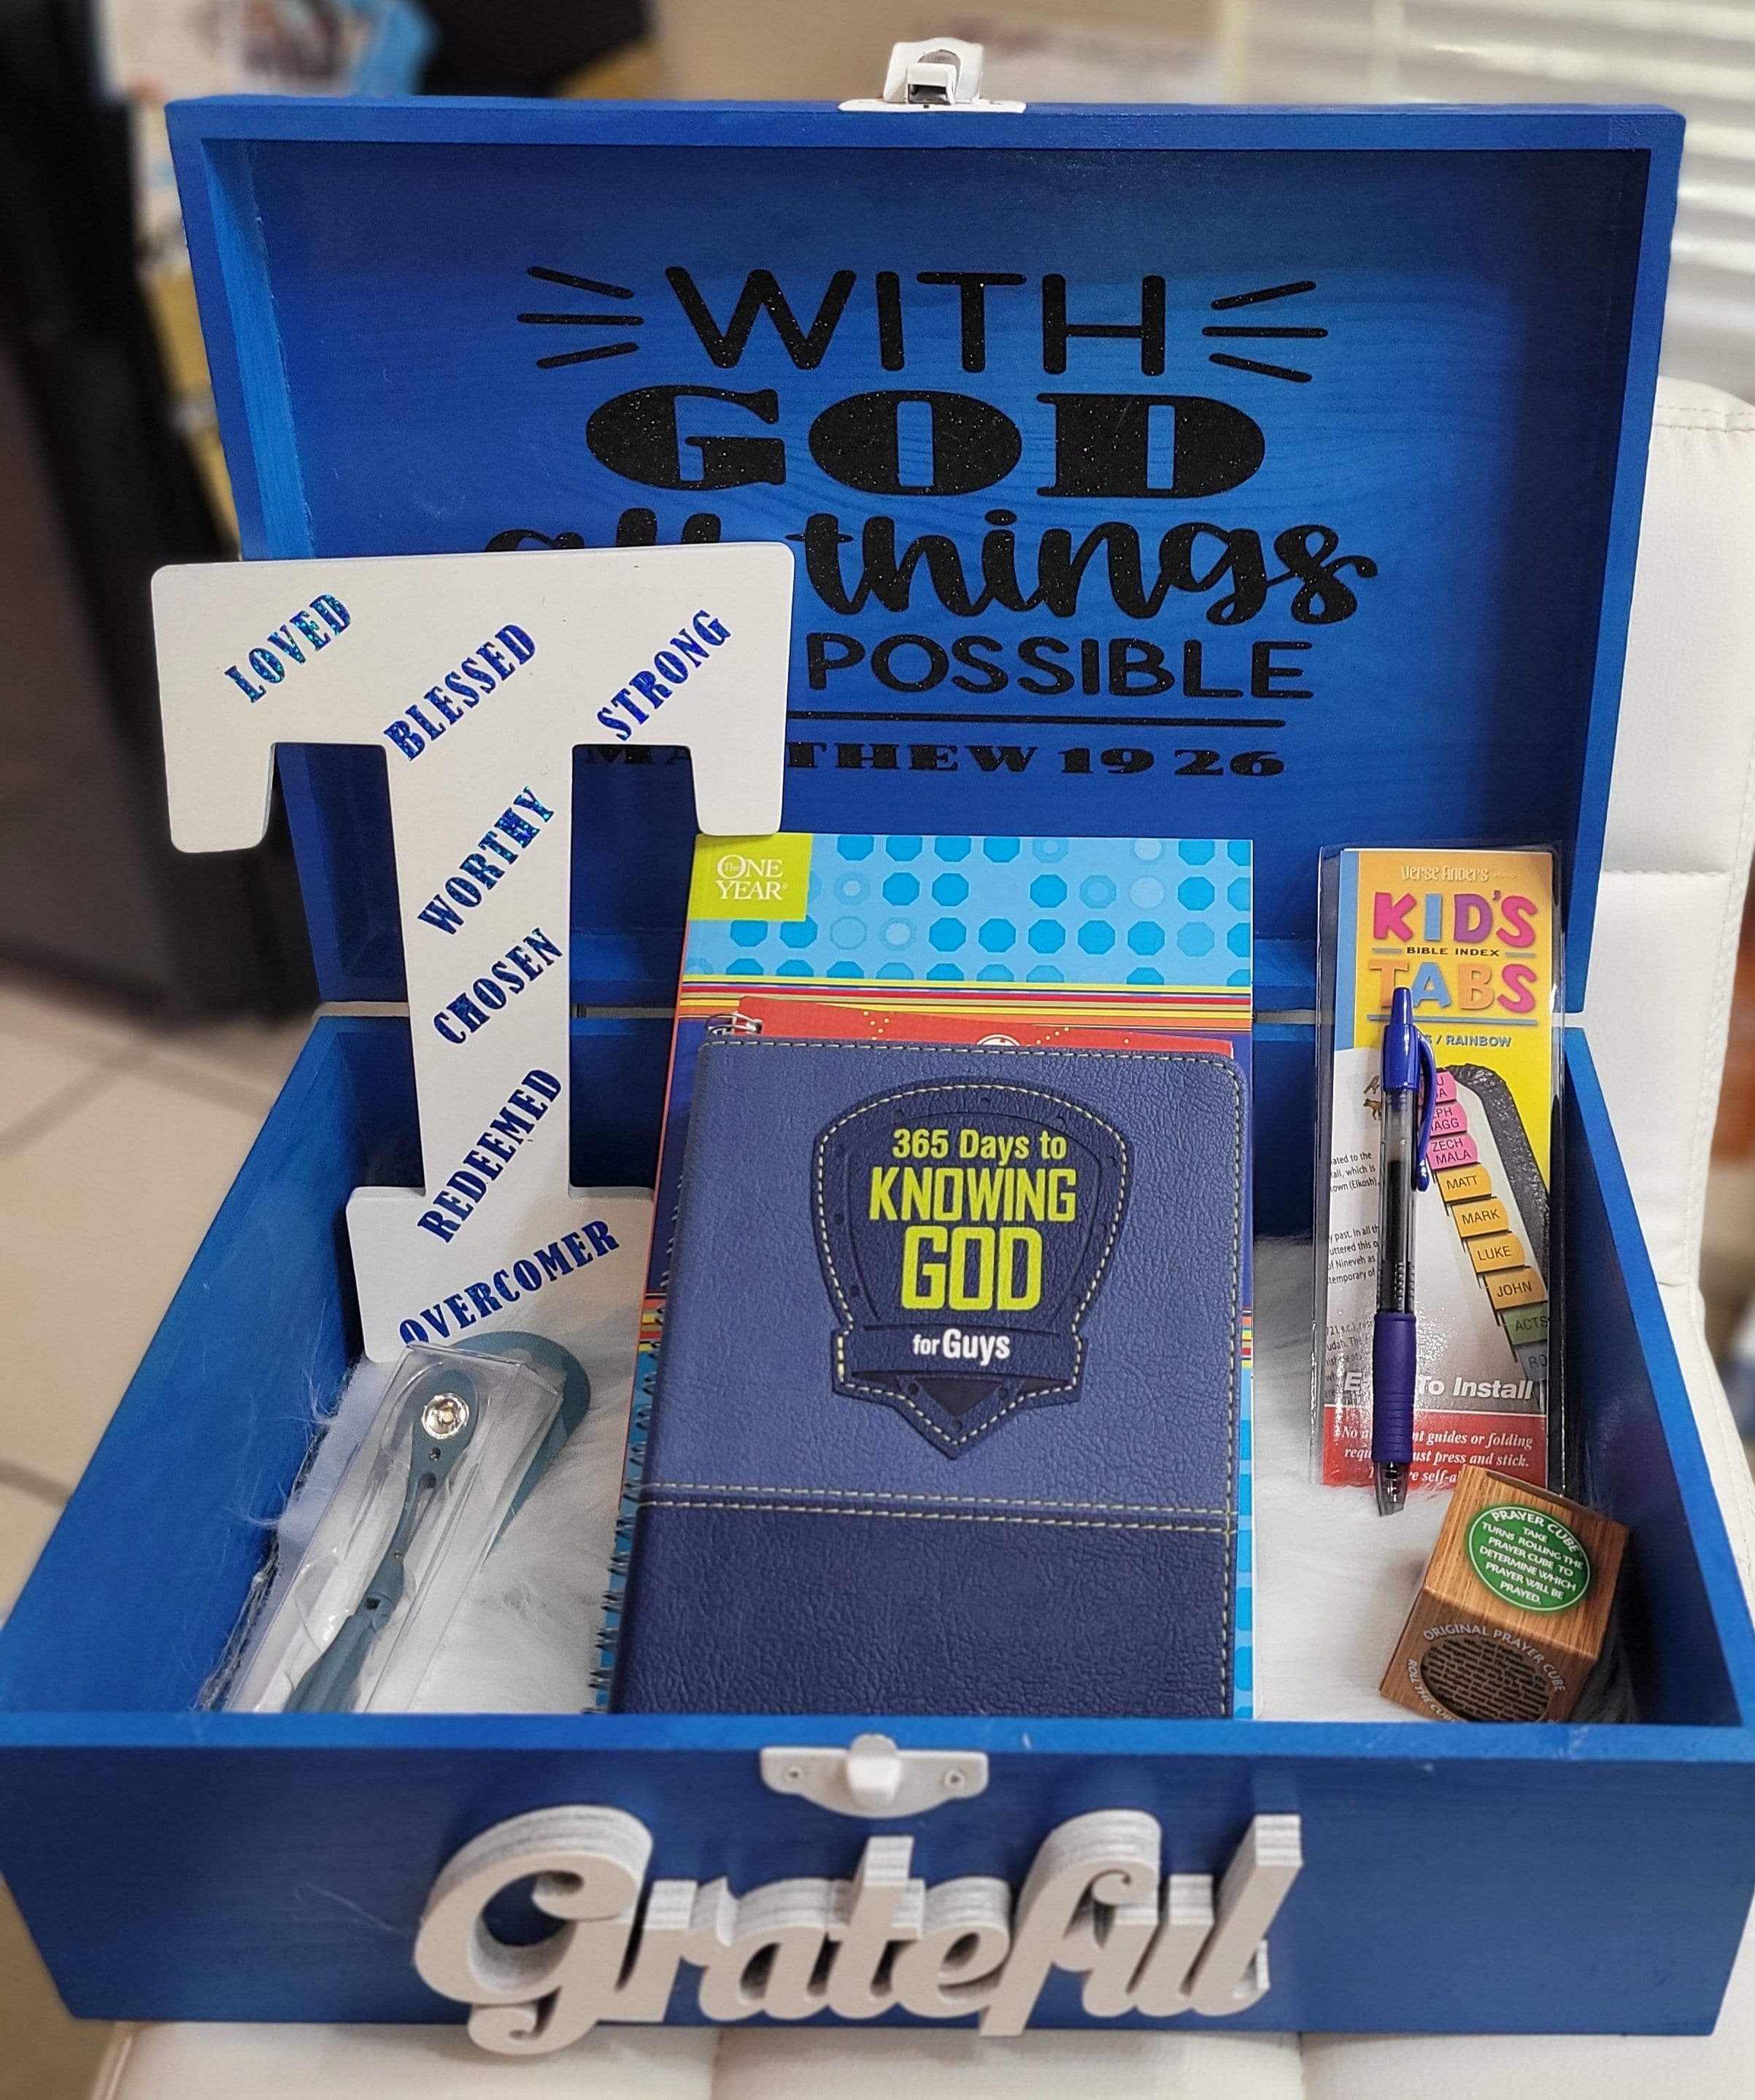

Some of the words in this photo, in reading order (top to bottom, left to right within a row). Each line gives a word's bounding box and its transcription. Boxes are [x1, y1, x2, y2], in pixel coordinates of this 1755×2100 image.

[666, 266, 1165, 376] WITH
[586, 385, 1265, 498] GOD
[785, 509, 1378, 625] things
[224, 593, 352, 704] LOVED
[806, 633, 1314, 699] POSSIBLE
[383, 624, 537, 762] BLESSED
[596, 609, 732, 742] STRONG
[1058, 747, 1154, 775] 19
[1174, 749, 1284, 777] 26
[417, 785, 555, 936] WORTHY
[717, 854, 783, 880] ONE
[1401, 865, 1439, 881] Verse
[1373, 890, 1538, 947] KID'S
[1407, 947, 1449, 955] BIBLE
[1455, 948, 1500, 957] INDEX
[433, 928, 563, 1045] CHOSEN
[1369, 960, 1538, 1013] TABS
[1446, 1035, 1512, 1048] RAINBOW
[417, 1069, 562, 1243] REDEEMED
[892, 1129, 949, 1159] 365
[960, 1129, 1030, 1166] Days
[1040, 1131, 1068, 1159] to
[1350, 1154, 1358, 1162] to
[1359, 1151, 1373, 1160] the
[1430, 1138, 1464, 1152] ZECH
[1436, 1150, 1472, 1166] MALA
[1346, 1165, 1368, 1177] which
[1368, 1164, 1376, 1172] is
[1446, 1174, 1478, 1191] MATT
[869, 1166, 1077, 1222] KNOWING
[1335, 1230, 1352, 1242] past.
[1353, 1228, 1361, 1236] In
[1362, 1226, 1371, 1235] all
[1462, 1208, 1501, 1225] MARK
[1330, 1242, 1356, 1255] uttered
[1357, 1240, 1372, 1250] this
[1335, 1255, 1367, 1269] Nineveh
[1368, 1255, 1376, 1263] as
[1477, 1245, 1512, 1261] LUKE
[399, 1219, 620, 1345] OVERCOMER
[901, 1226, 1044, 1312] GOD
[1368, 1267, 1376, 1277] of
[1497, 1281, 1532, 1298] JOHN
[1516, 1316, 1548, 1332] ACTS
[913, 1334, 940, 1355] for
[943, 1328, 1011, 1366] Guys
[1453, 1376, 1533, 1399] Install
[1342, 1426, 1357, 1438] No
[1427, 1430, 1467, 1445] guides
[1471, 1435, 1484, 1445] or
[1486, 1433, 1532, 1450] folding
[1413, 1452, 1431, 1461] ust
[1434, 1453, 1465, 1465] press
[1469, 1454, 1494, 1466] and
[1497, 1455, 1530, 1467] stick.
[1482, 1521, 1516, 1541] TURNS
[1518, 1536, 1562, 1560] ROLLING
[1562, 1555, 1584, 1569] THE
[1492, 1510, 1545, 1527] PRAYER
[1547, 1523, 1581, 1553] CUBE
[1522, 1526, 1548, 1542] TAKE
[1479, 1545, 1538, 1575] DETERMINE
[1538, 1569, 1577, 1593] WHICH
[1489, 1536, 1527, 1558] PRAYER
[1527, 1553, 1555, 1569] CUBE
[1558, 1564, 1574, 1577] TO
[1486, 1561, 1524, 1584] PRAYER
[1526, 1577, 1549, 1594] WILL
[1551, 1588, 1565, 1600] BE
[1424, 1623, 1489, 1641] ORIGINAL
[1493, 1628, 1545, 1664] PRAYER
[1543, 1664, 1567, 1693] CUBE
[1408, 1658, 1419, 1684] ROLL
[1414, 1685, 1432, 1704] THE
[414, 1804, 1303, 2055] Grateful
